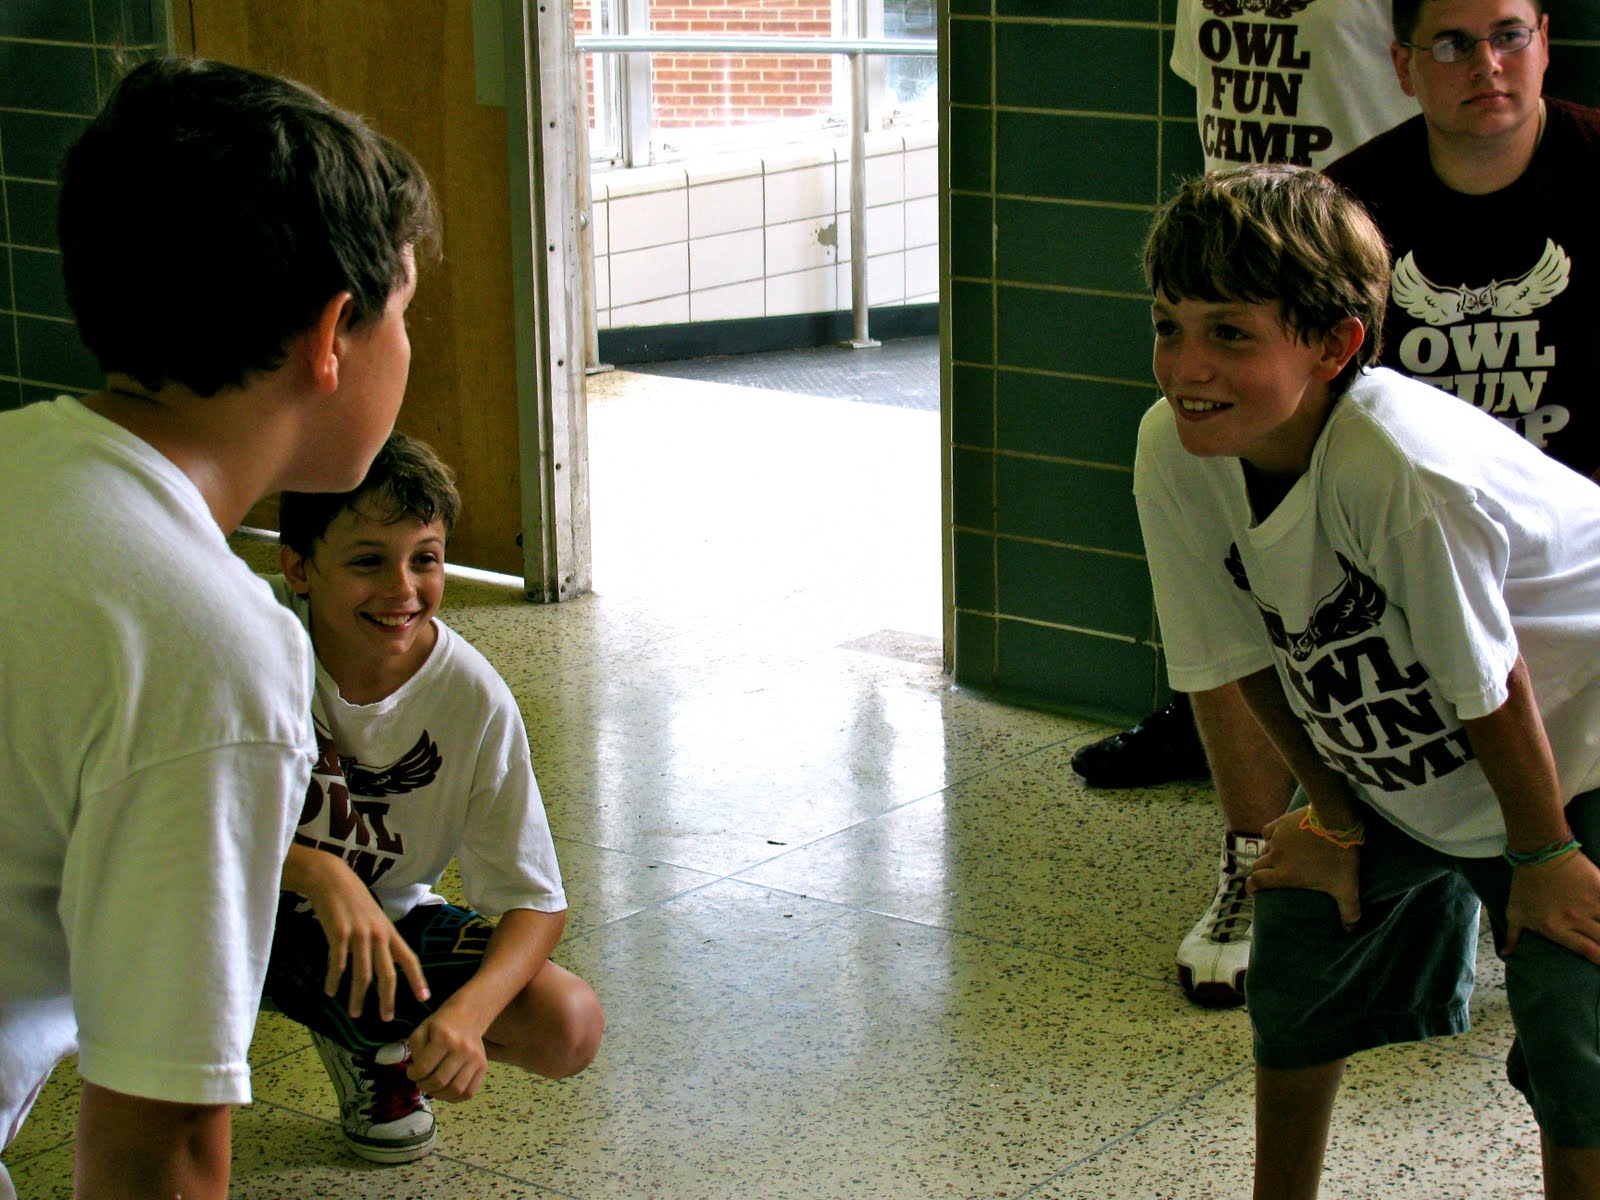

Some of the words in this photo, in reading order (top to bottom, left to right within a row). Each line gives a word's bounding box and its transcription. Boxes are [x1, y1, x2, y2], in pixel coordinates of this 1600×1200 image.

[1198, 19, 1310, 70] OWL
[1211, 66, 1303, 118] FUN
[1202, 114, 1333, 167] CAMP
[1399, 320, 1556, 374] OWL
[1412, 371, 1548, 414] UN
[1286, 636, 1431, 713] WL
[1303, 688, 1447, 754] UN
